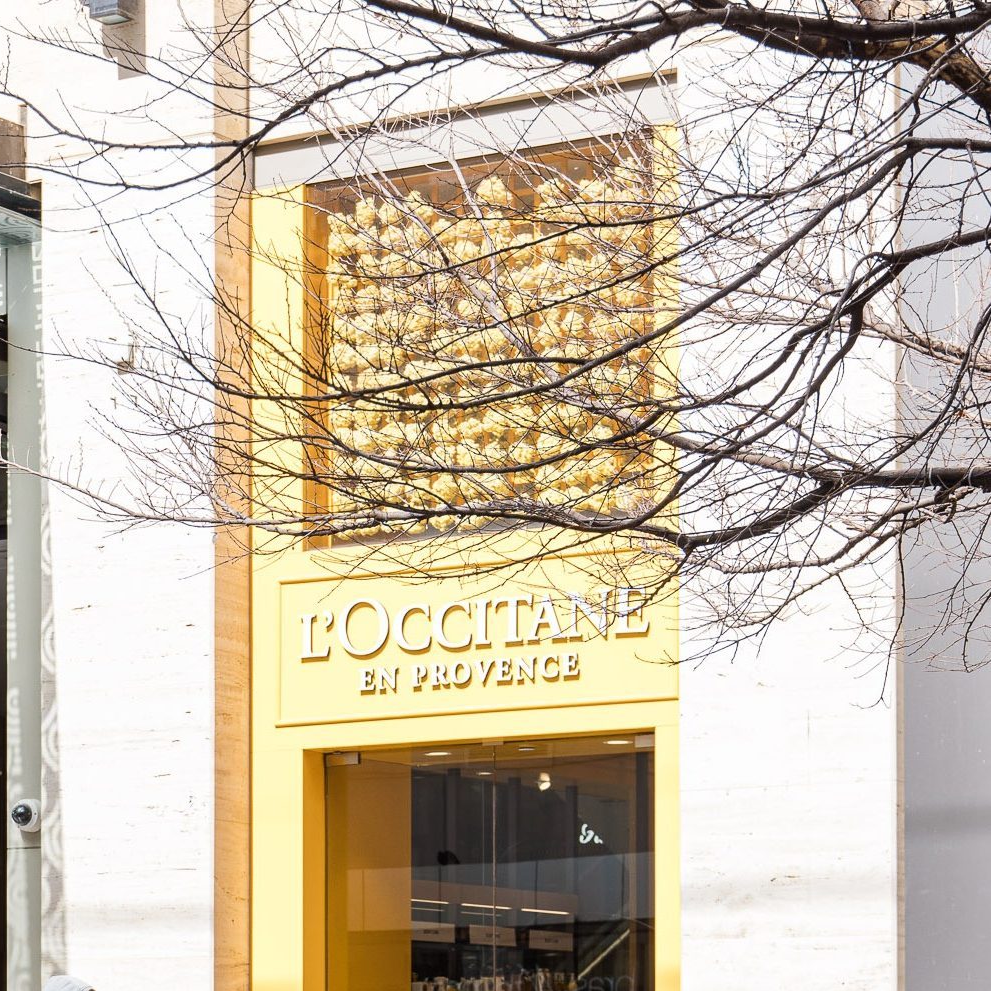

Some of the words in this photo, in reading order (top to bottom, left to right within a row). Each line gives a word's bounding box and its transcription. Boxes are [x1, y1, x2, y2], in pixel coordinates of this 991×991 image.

[300, 587, 650, 662] L'OCCITANE
[359, 666, 399, 695] EN
[411, 652, 580, 692] PROVENCE
